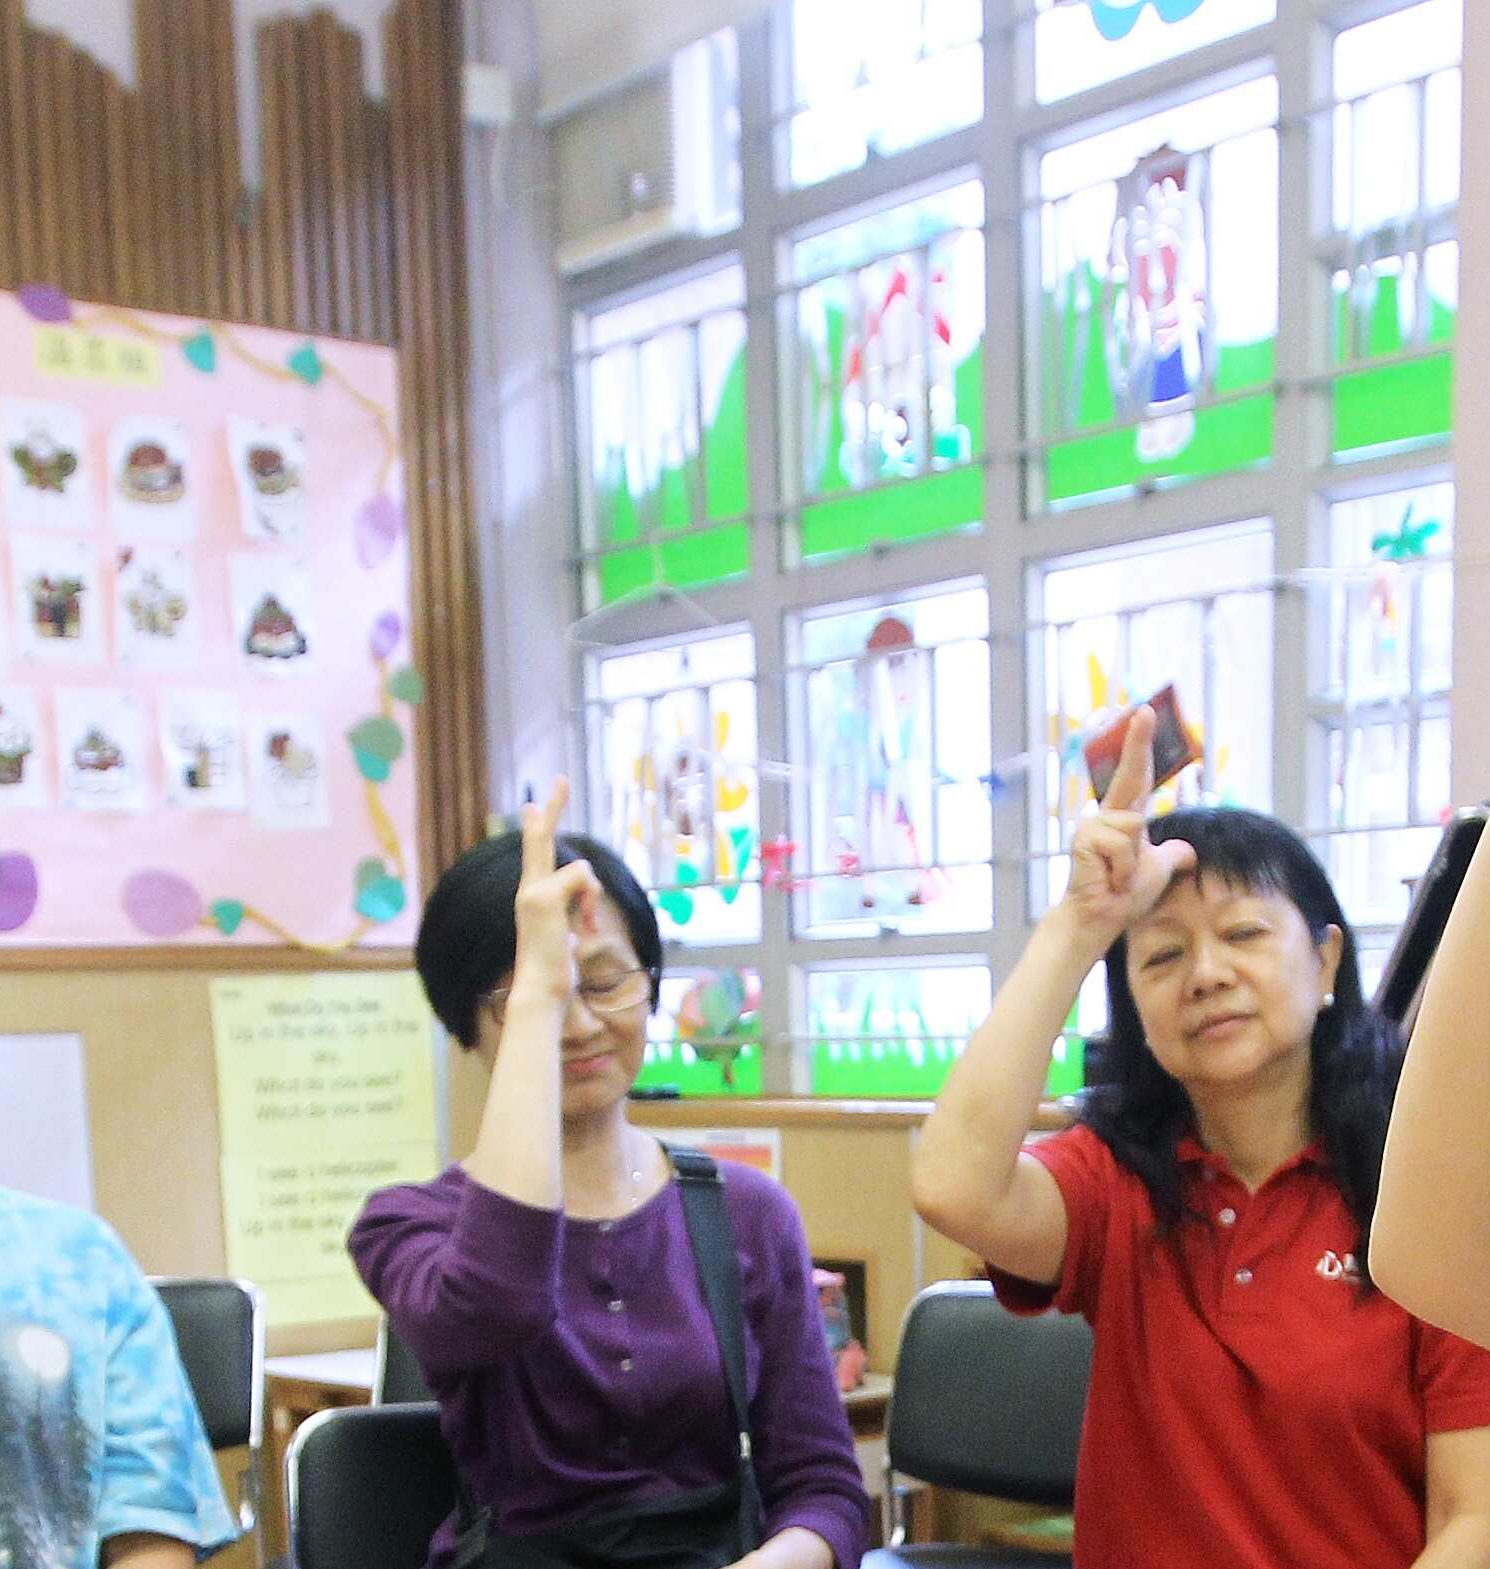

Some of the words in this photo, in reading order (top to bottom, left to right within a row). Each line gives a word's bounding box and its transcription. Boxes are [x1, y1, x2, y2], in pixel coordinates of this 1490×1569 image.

[254, 1076, 300, 1093] What
[303, 1076, 324, 1091] do
[330, 1076, 358, 1092] you
[364, 1068, 402, 1087] see?
[255, 1103, 300, 1120] What
[306, 1103, 326, 1118] do
[332, 1103, 359, 1119] you
[365, 1095, 403, 1114] see?
[267, 1166, 298, 1180] see
[269, 1192, 300, 1208] see
